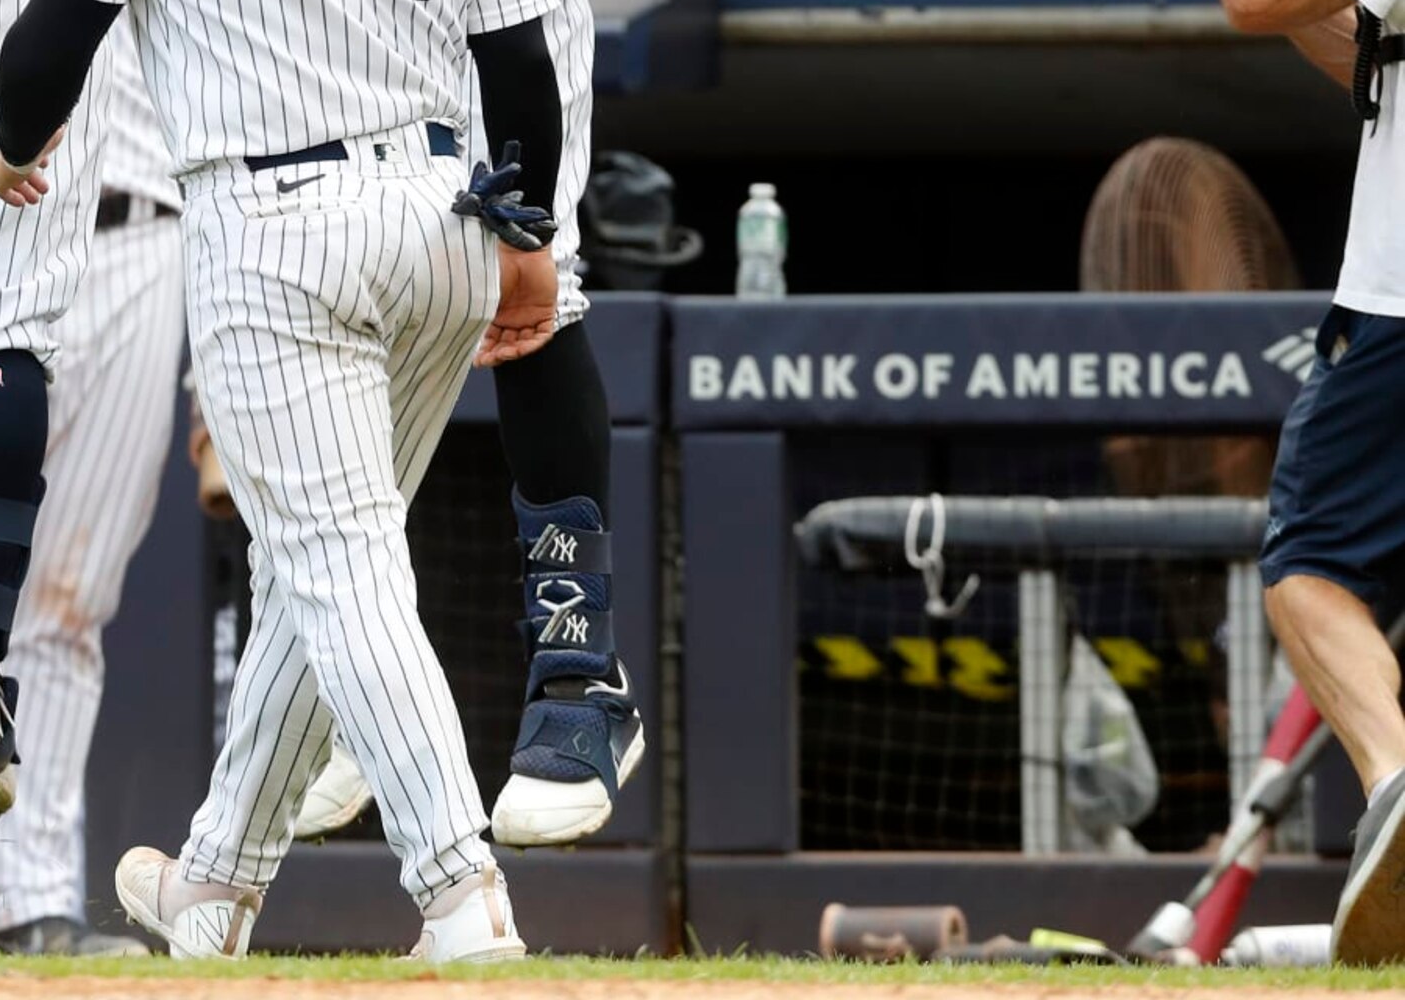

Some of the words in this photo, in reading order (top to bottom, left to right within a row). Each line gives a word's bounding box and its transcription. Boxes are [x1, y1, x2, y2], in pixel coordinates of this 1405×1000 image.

[689, 354, 858, 400] BANK
[873, 353, 954, 399] OF
[965, 352, 1252, 400] AMERICA
[550, 533, 578, 563] NY
[562, 614, 589, 643] NY
